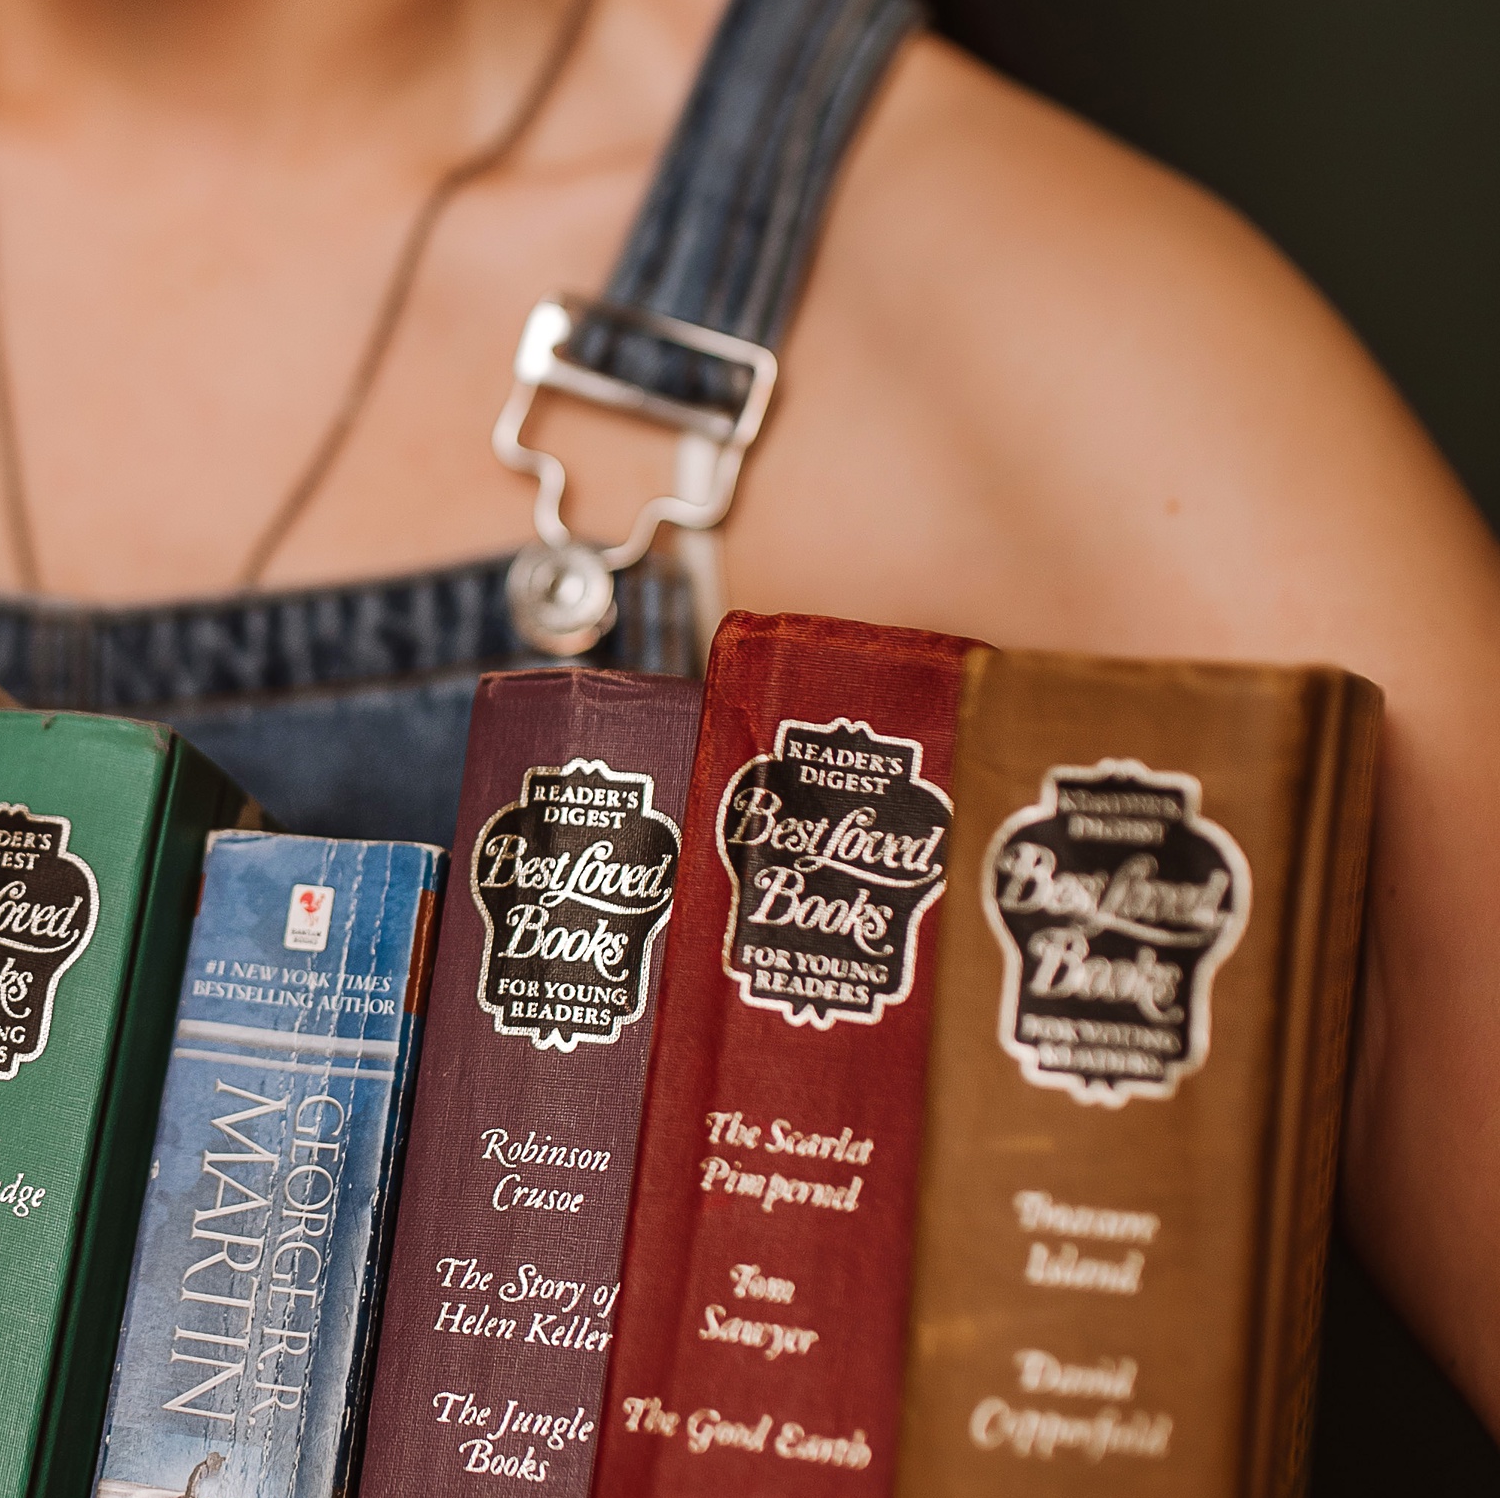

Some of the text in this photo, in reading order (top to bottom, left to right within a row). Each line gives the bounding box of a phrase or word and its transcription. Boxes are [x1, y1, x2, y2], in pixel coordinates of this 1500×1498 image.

[787, 739, 905, 775] READER'S
[534, 785, 639, 810] READER'S
[799, 765, 891, 795] DIGEST
[544, 807, 627, 829] DIGEST
[727, 787, 946, 889] Best Loved
[480, 834, 673, 914] Best Loved
[748, 865, 894, 957] Books
[497, 904, 630, 982] Books
[205, 959, 393, 993] #1 NEW YORK TIMES
[742, 944, 889, 985] FOR YOUNG
[1027, 924, 1185, 1026] Books
[192, 980, 396, 1016] BESTSELLING AUTHOR
[497, 978, 628, 1005] FOR YOUNG
[754, 969, 870, 1005] READERS
[510, 1001, 612, 1025] READERS
[480, 1127, 612, 1173] Robinson
[706, 1110, 762, 1149] The
[267, 1093, 345, 1310] GEORGE
[491, 1173, 585, 1214] Crusoe
[161, 1077, 290, 1423] MARTIN
[435, 1257, 620, 1319] The Story of
[729, 1263, 796, 1304] Tom
[433, 1301, 613, 1353] Helen Keller
[432, 1391, 596, 1451] The Jungle
[621, 1396, 681, 1438] The
[458, 1438, 551, 1483] Books
